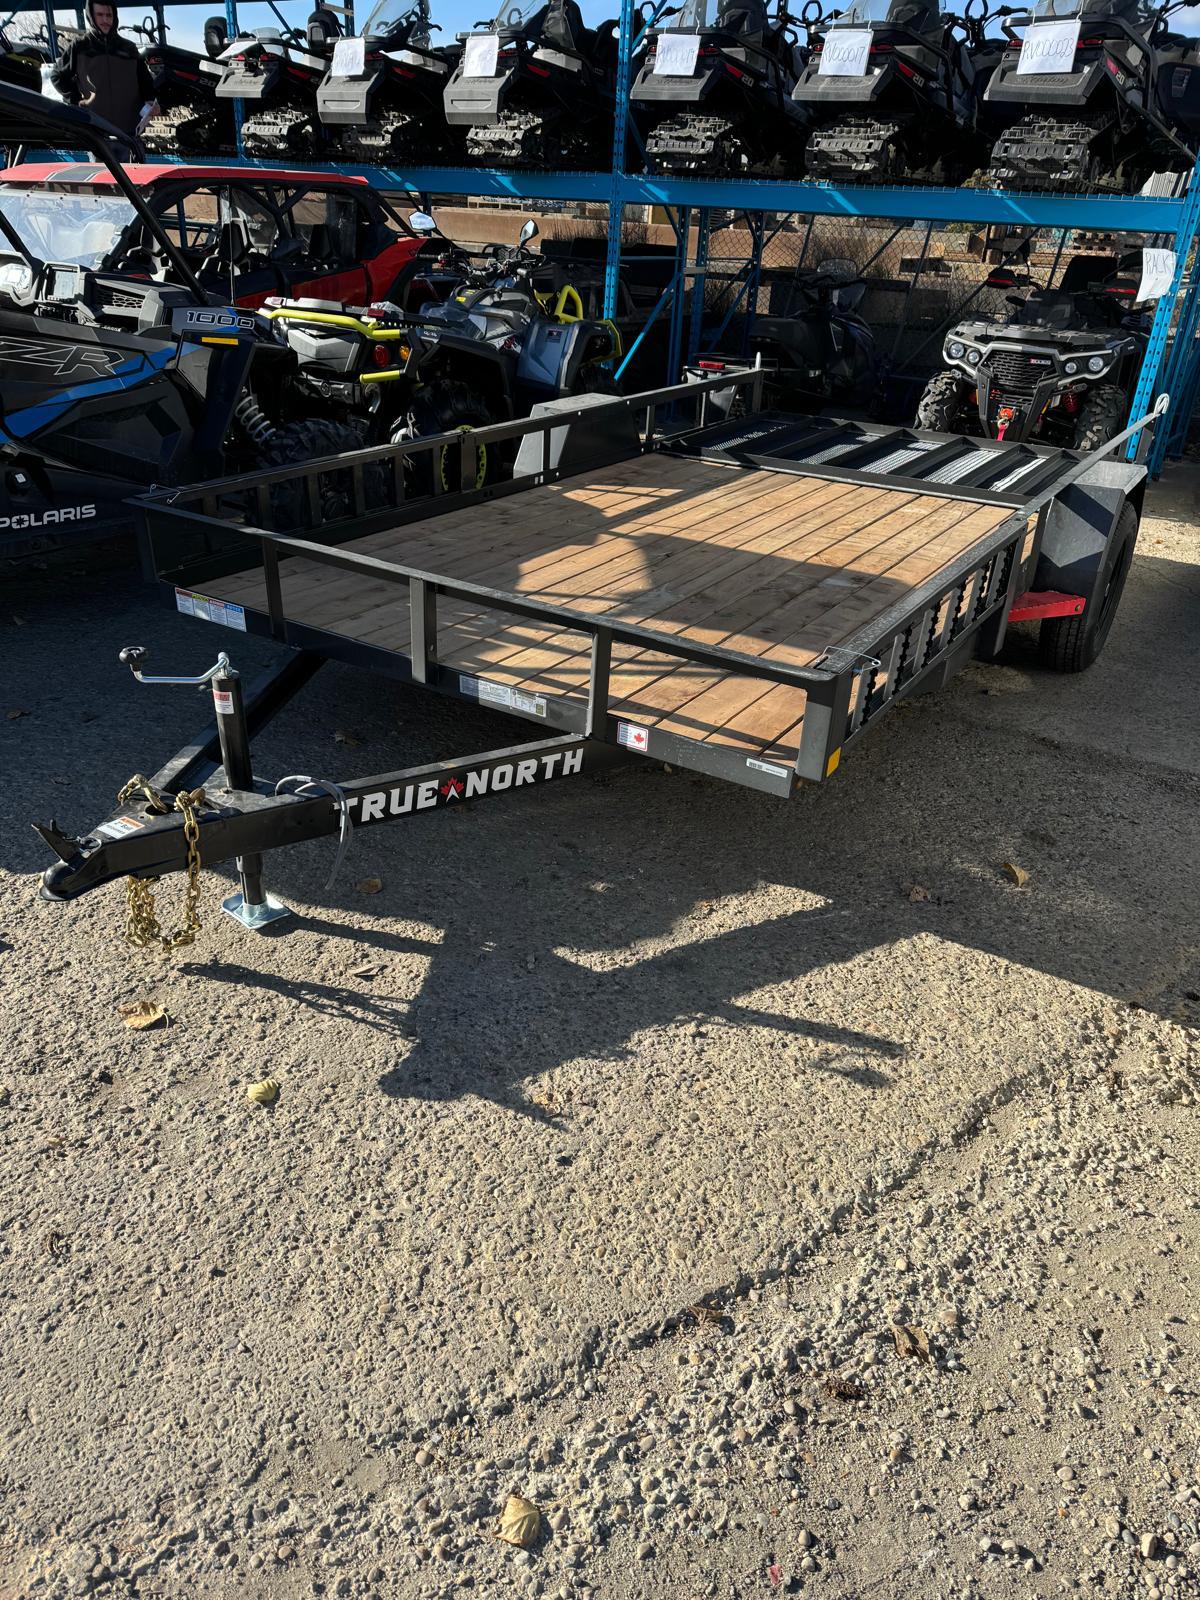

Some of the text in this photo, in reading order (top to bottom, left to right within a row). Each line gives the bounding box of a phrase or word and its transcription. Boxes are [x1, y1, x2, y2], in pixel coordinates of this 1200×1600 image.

[186, 310, 255, 330] 1000
[0, 504, 97, 529] POLARIS
[465, 748, 585, 798] NORTH
